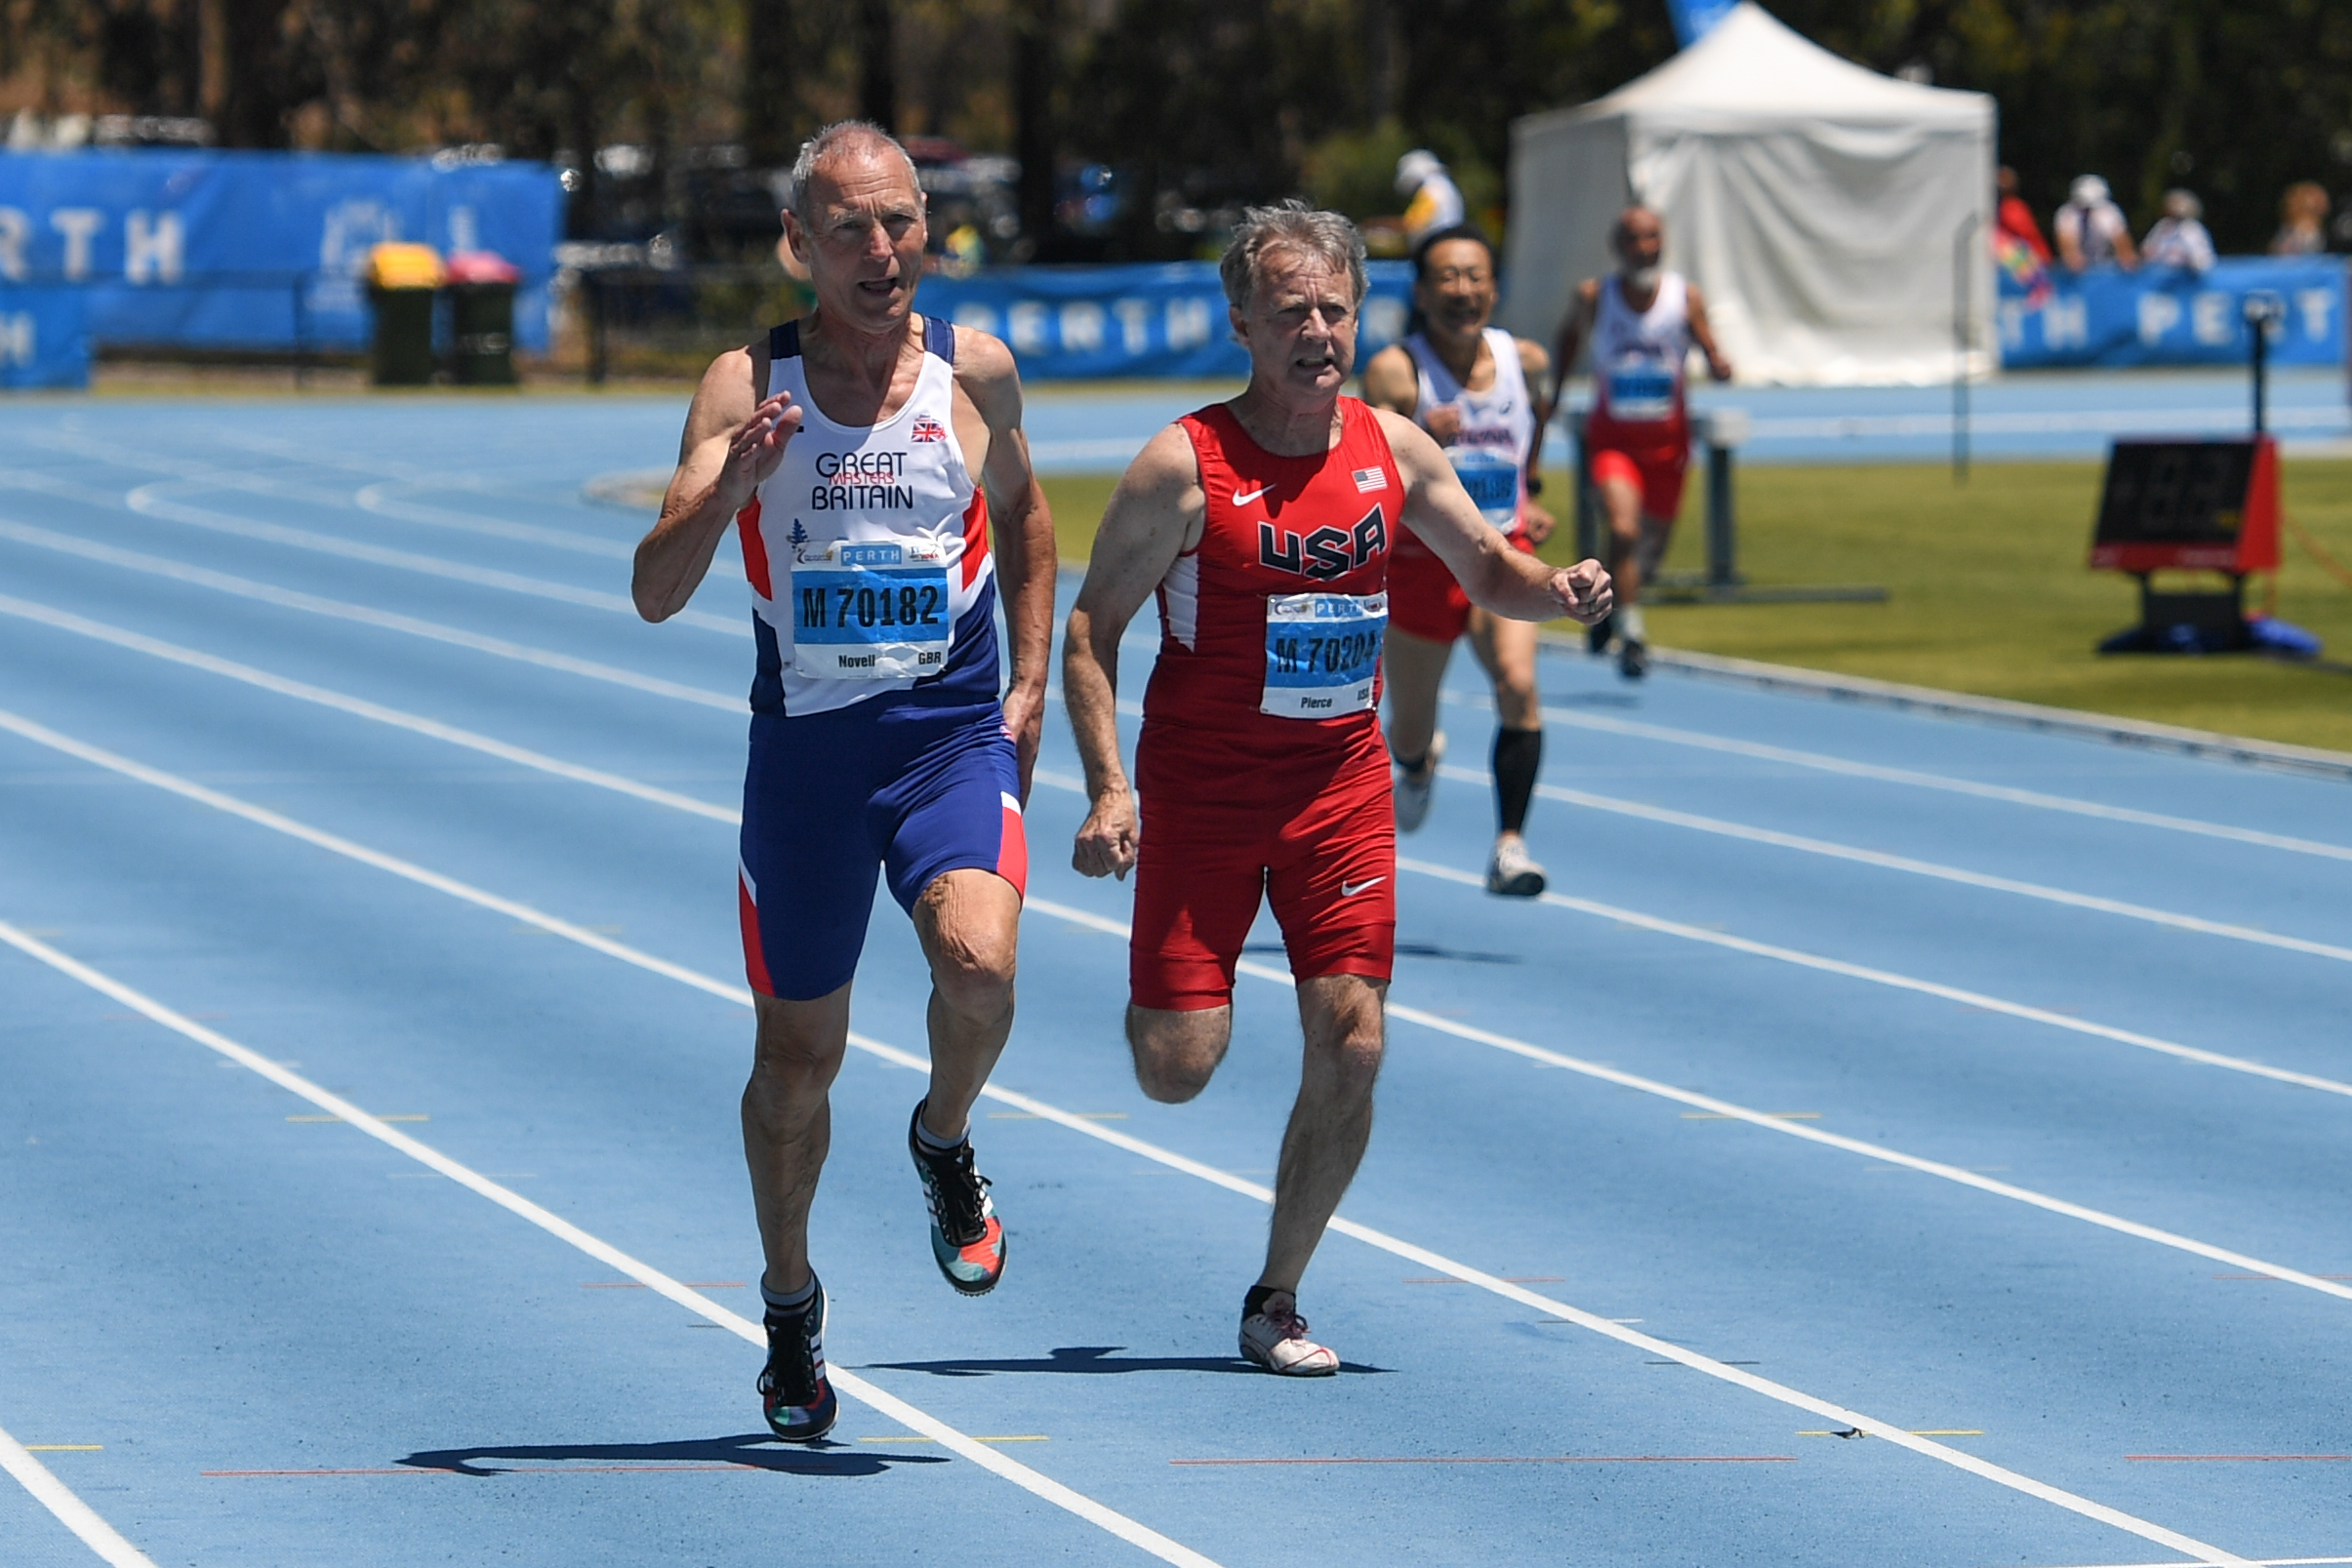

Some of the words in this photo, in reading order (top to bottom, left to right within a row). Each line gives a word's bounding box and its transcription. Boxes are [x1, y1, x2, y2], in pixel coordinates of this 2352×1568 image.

[953, 299, 1211, 355] PERTH
[816, 452, 908, 478] GREAT
[829, 471, 895, 485] MASTERS
[812, 485, 913, 510] BRITAIN
[1257, 502, 1388, 582] USA
[842, 549, 900, 562] PERTH
[803, 587, 826, 627] M
[836, 585, 938, 627] 70182
[838, 654, 875, 668] Novell
[918, 651, 942, 665] GBR
[1277, 637, 1297, 673] M
[1301, 697, 1332, 709] Pierce
